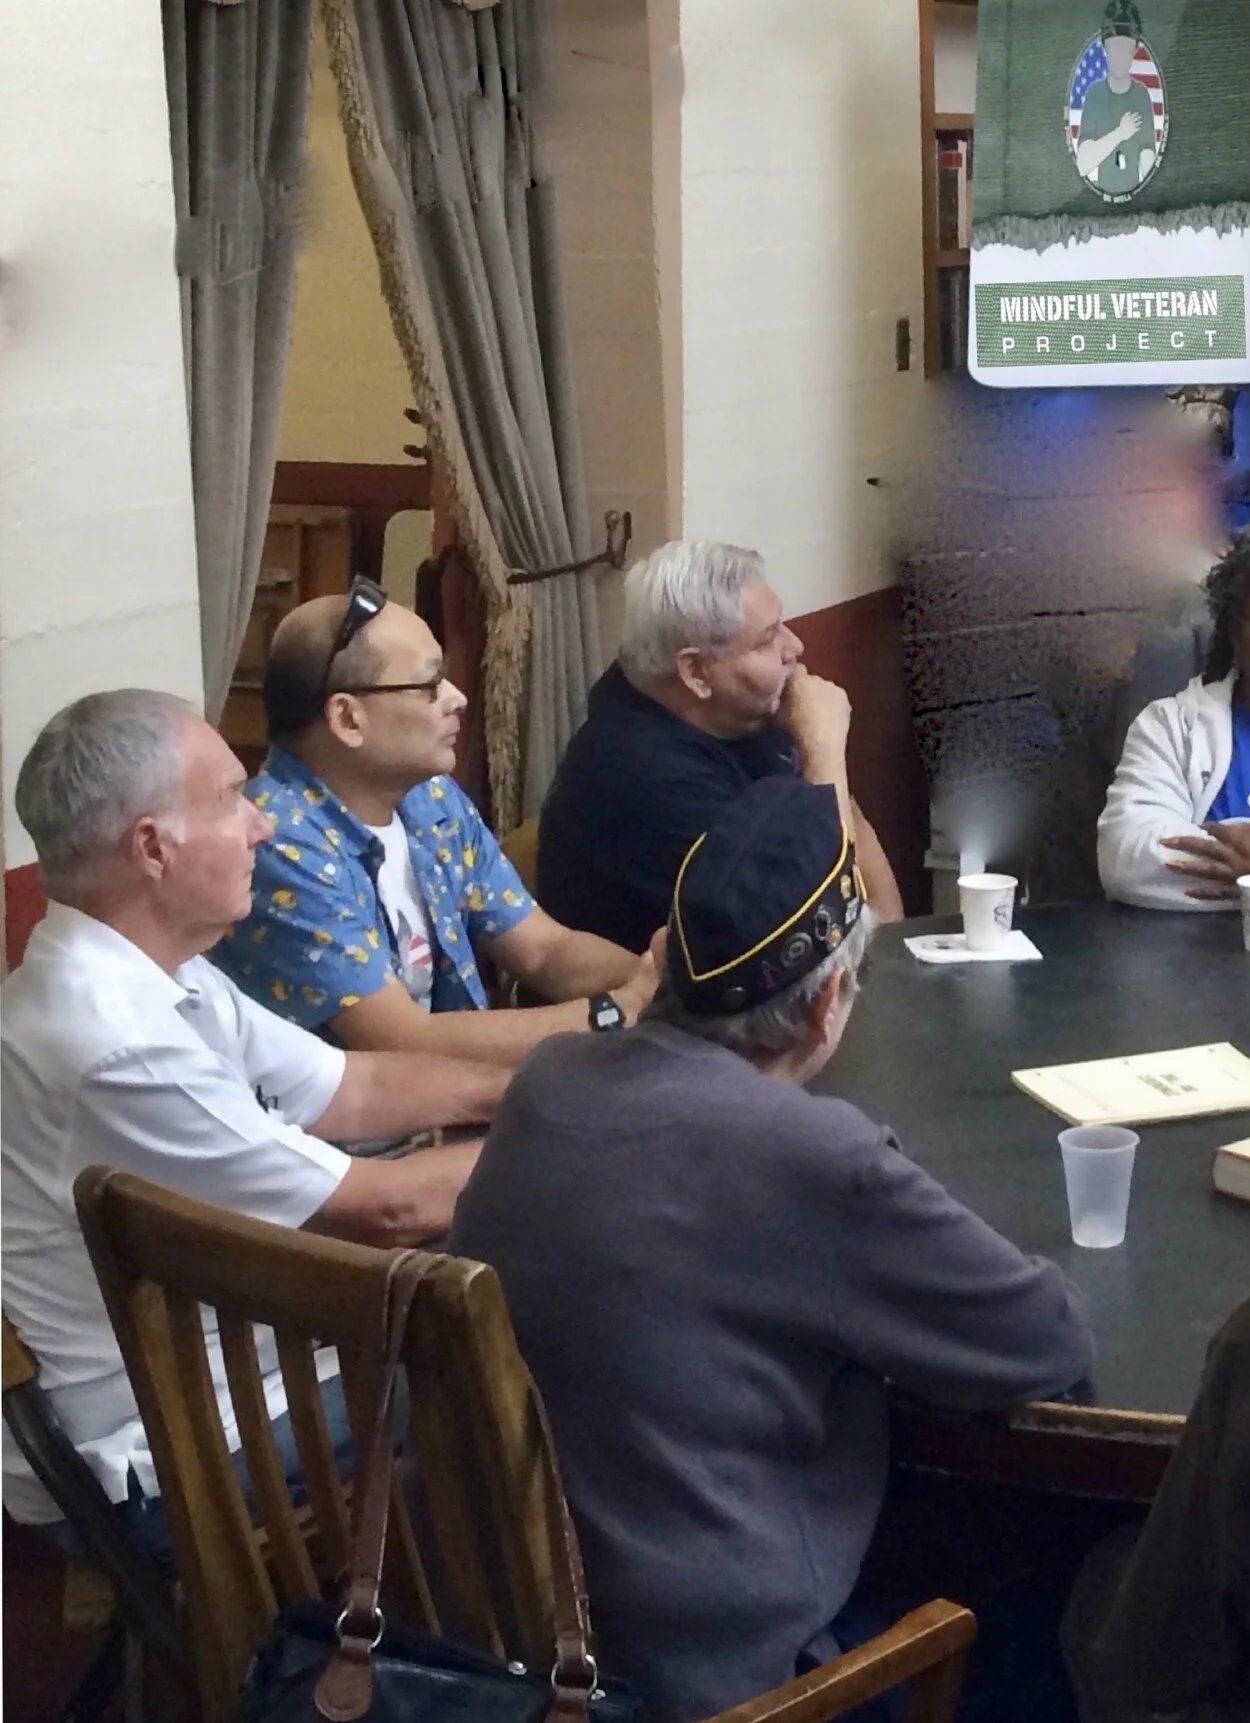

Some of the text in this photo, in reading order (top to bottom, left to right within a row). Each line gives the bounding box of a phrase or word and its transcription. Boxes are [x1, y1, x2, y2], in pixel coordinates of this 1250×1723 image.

[1000, 290, 1218, 322] MINDFUL VETERAN
[1002, 330, 1218, 354] PROJECT
